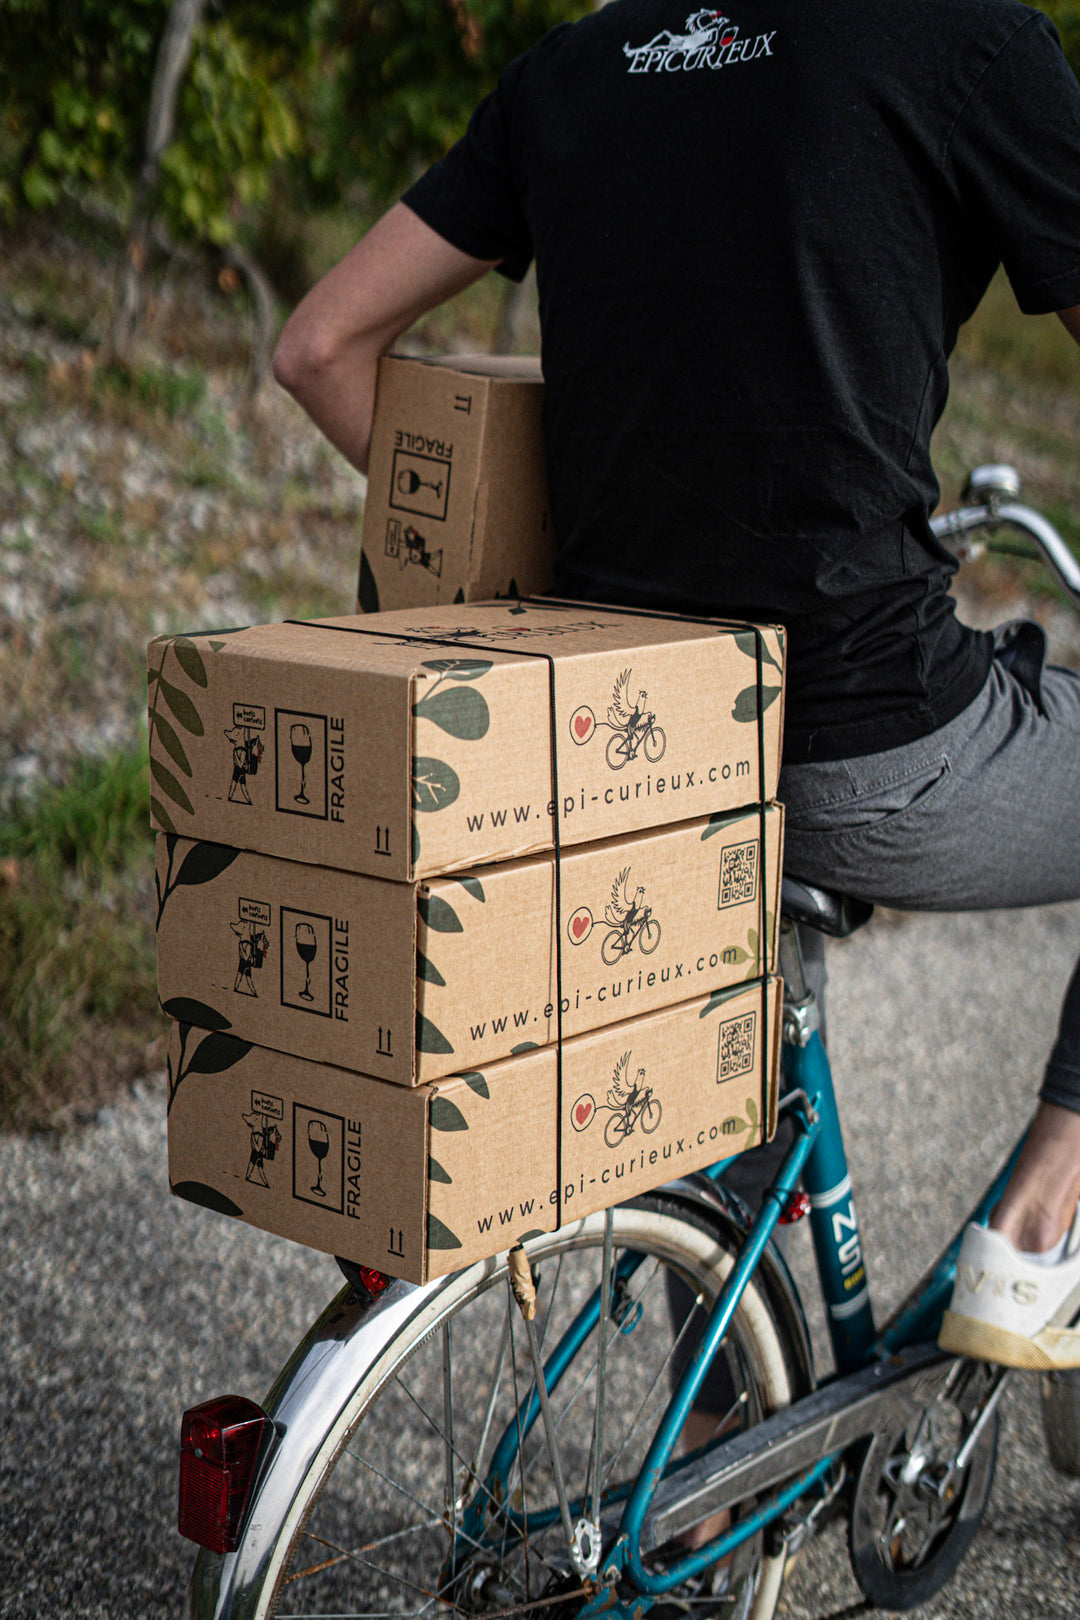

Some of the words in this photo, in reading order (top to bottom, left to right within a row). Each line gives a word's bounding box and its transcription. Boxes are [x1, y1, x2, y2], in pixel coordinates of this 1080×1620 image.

[627, 30, 777, 73] EPICURIEUX
[395, 431, 453, 458] FRAGILE
[330, 716, 345, 823] FRAGILE
[466, 759, 751, 832] www.epi-curieux.com
[335, 918, 349, 1022] FRAGILE
[470, 947, 737, 1041] www.epi-curieux.com
[347, 1119, 362, 1220] FRAGILE
[477, 1117, 736, 1234] www.epi-curieux.com
